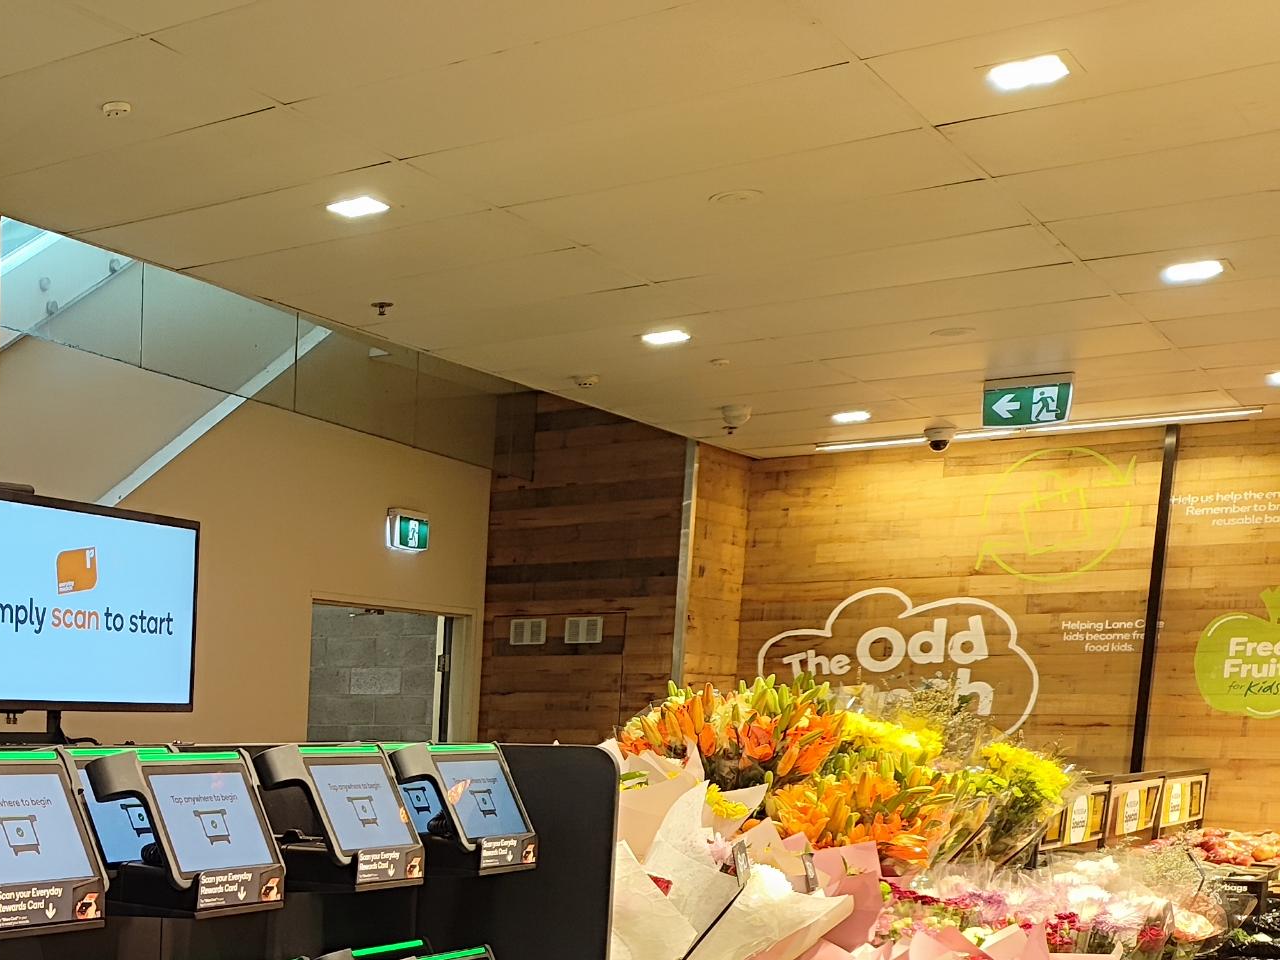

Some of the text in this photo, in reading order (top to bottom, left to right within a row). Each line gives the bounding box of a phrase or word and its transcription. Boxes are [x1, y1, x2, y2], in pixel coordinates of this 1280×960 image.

[1200, 495, 1214, 503] us
[1216, 492, 1242, 503] help
[1243, 491, 1264, 500] the
[1185, 504, 1252, 516] Remember
[1253, 504, 1266, 512] to
[1211, 514, 1263, 526] reusable
[51, 607, 99, 630] scan
[104, 608, 124, 632] to
[129, 610, 174, 635] start
[1062, 618, 1104, 632] Helping
[1105, 620, 1134, 630] Lane
[1064, 630, 1084, 641] kids
[1086, 630, 1130, 641] become
[782, 614, 989, 678] The Odd
[1084, 642, 1110, 652] food
